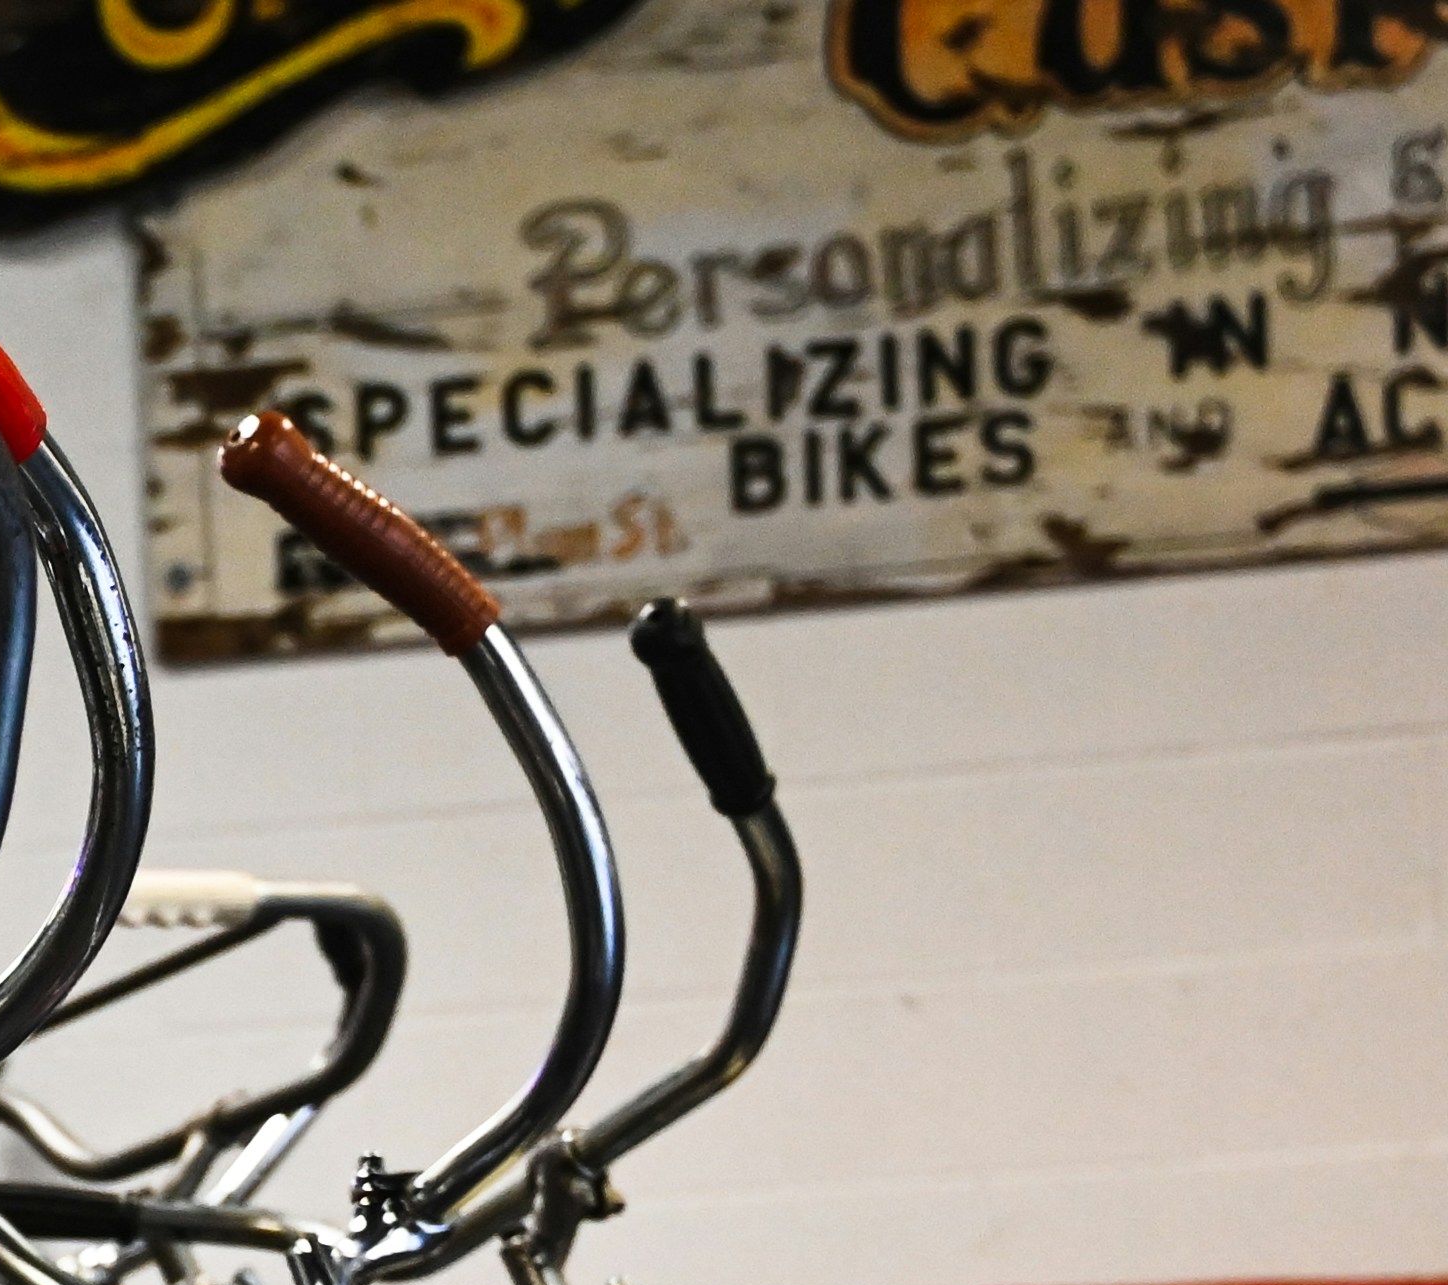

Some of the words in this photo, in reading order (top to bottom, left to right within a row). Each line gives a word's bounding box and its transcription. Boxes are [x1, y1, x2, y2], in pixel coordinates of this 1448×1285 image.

[518, 138, 1336, 352] Personalizing
[294, 314, 1052, 462] SPECIALIZING
[729, 409, 1038, 514] BIKES
